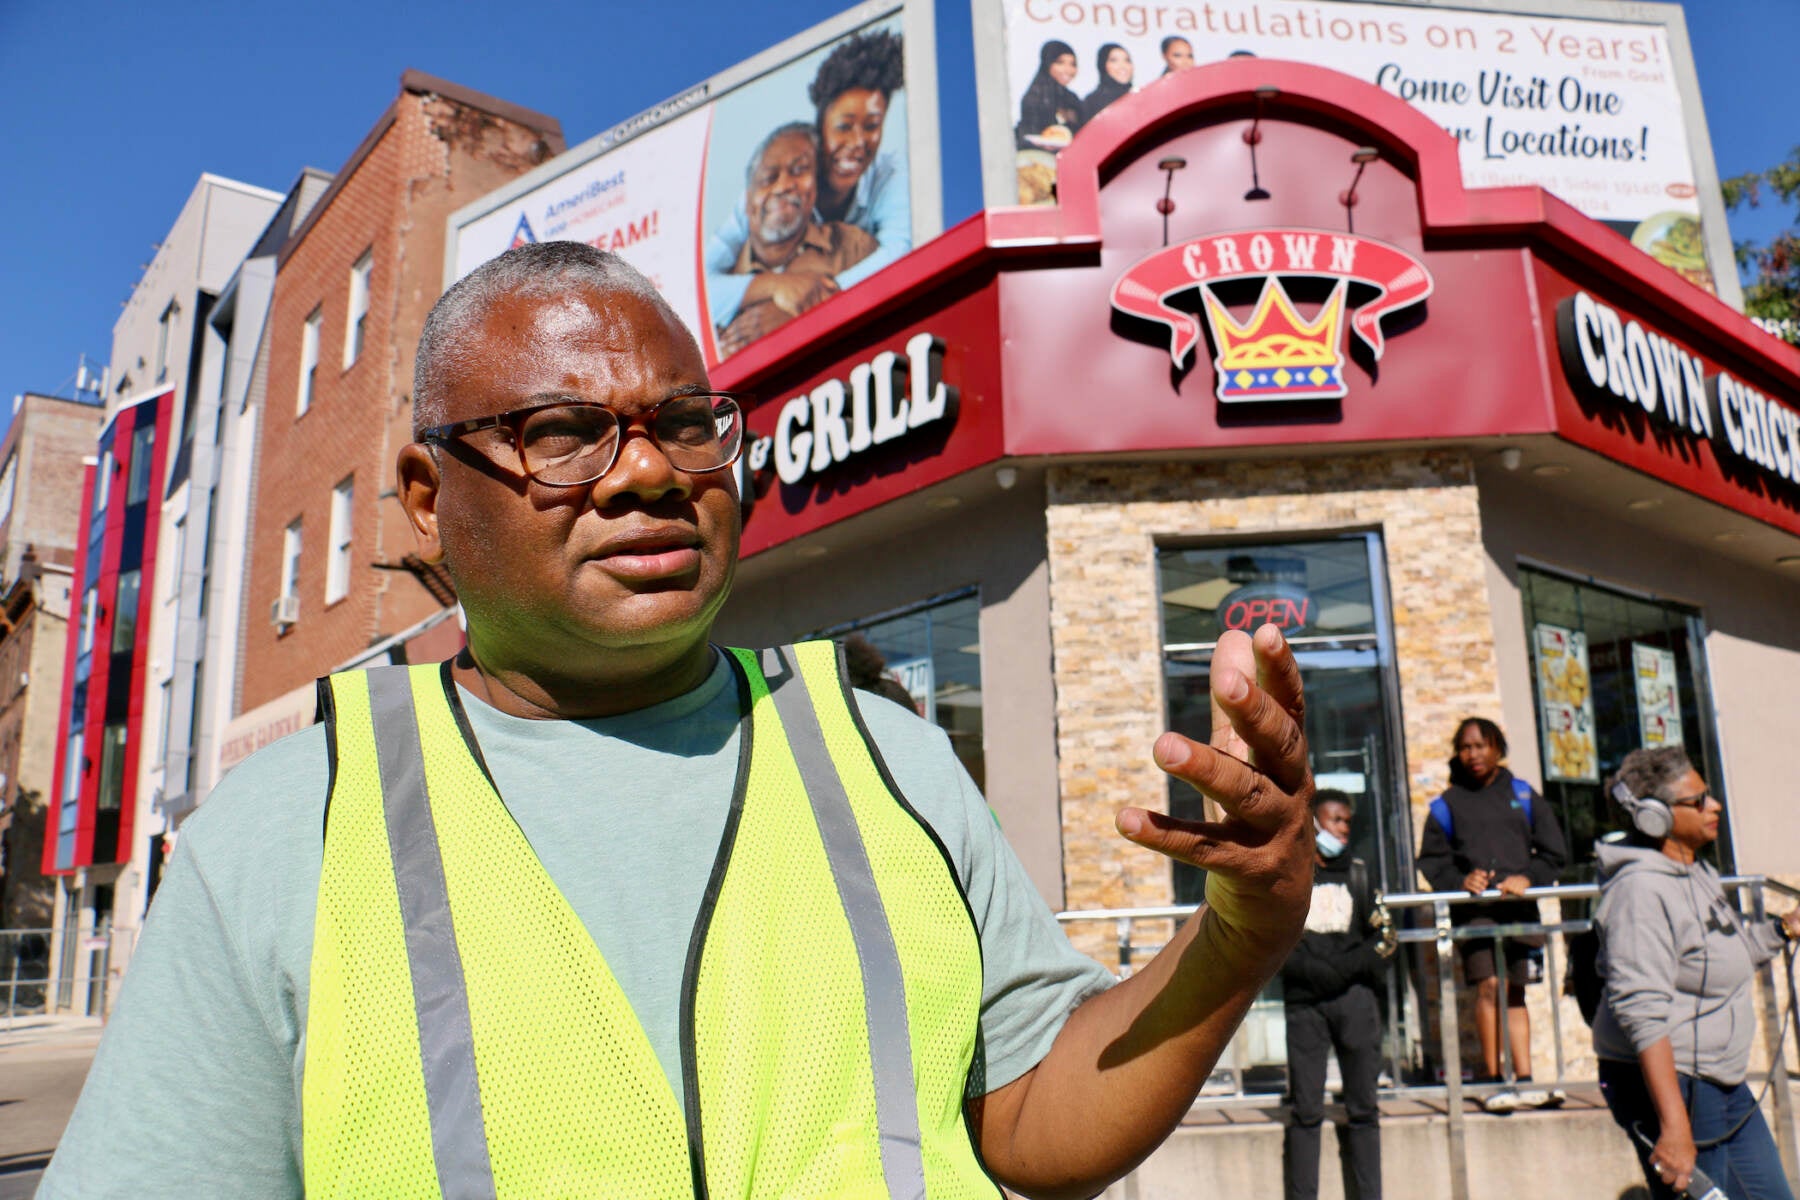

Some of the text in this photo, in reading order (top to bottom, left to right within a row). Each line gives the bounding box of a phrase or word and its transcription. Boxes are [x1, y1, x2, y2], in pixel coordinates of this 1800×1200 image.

[1024, 0, 1662, 64] Congratulations on 2 Years!
[1375, 63, 1622, 115] Come Visit One
[1483, 116, 1649, 162] Locations!
[587, 208, 659, 252] EAM!
[1182, 233, 1359, 279] CROWN
[1575, 291, 1713, 439] CROWN
[748, 435, 772, 471] &
[774, 332, 948, 485] GRILL
[1224, 597, 1309, 631] OPEN
